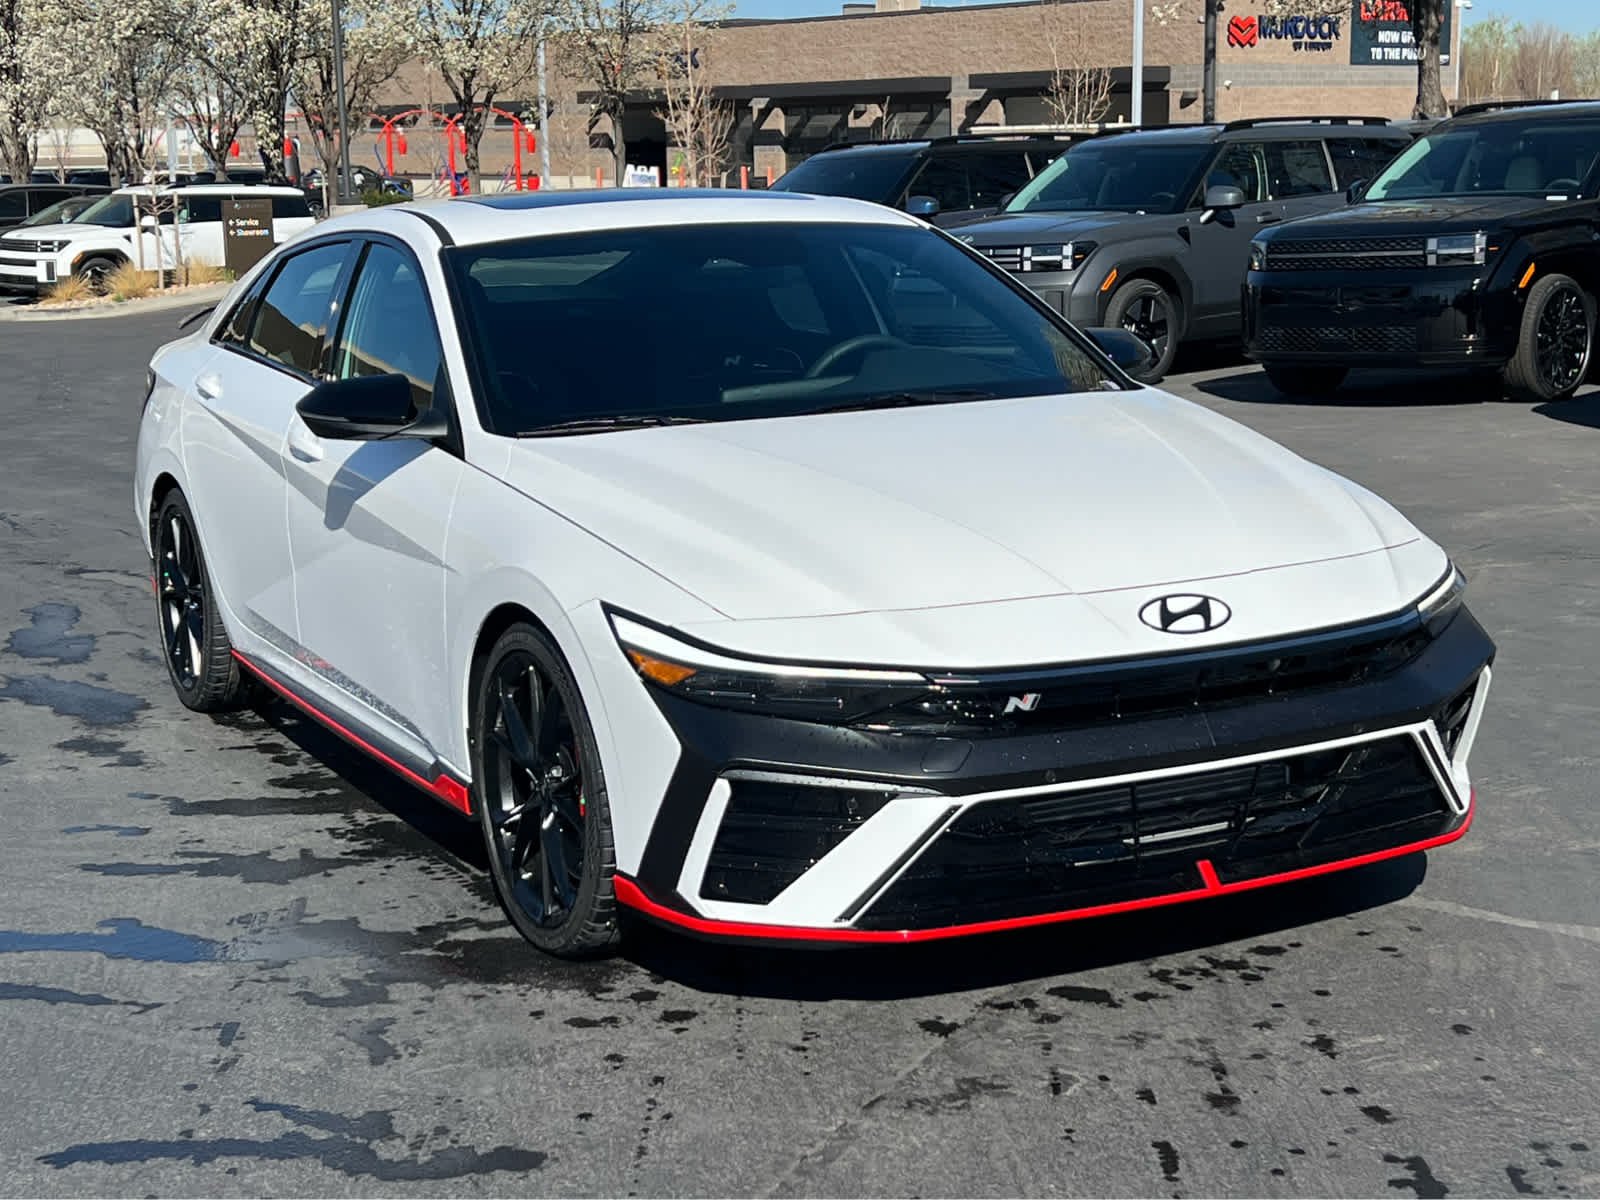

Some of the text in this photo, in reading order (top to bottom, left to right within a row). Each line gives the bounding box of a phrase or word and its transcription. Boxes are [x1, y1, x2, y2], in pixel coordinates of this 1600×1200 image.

[1378, 30, 1400, 43] NOW
[1371, 47, 1382, 60] TO
[1384, 47, 1400, 60] THE
[235, 218, 259, 227] Service
[236, 228, 269, 237] Showroom
[1003, 693, 1041, 713] N
